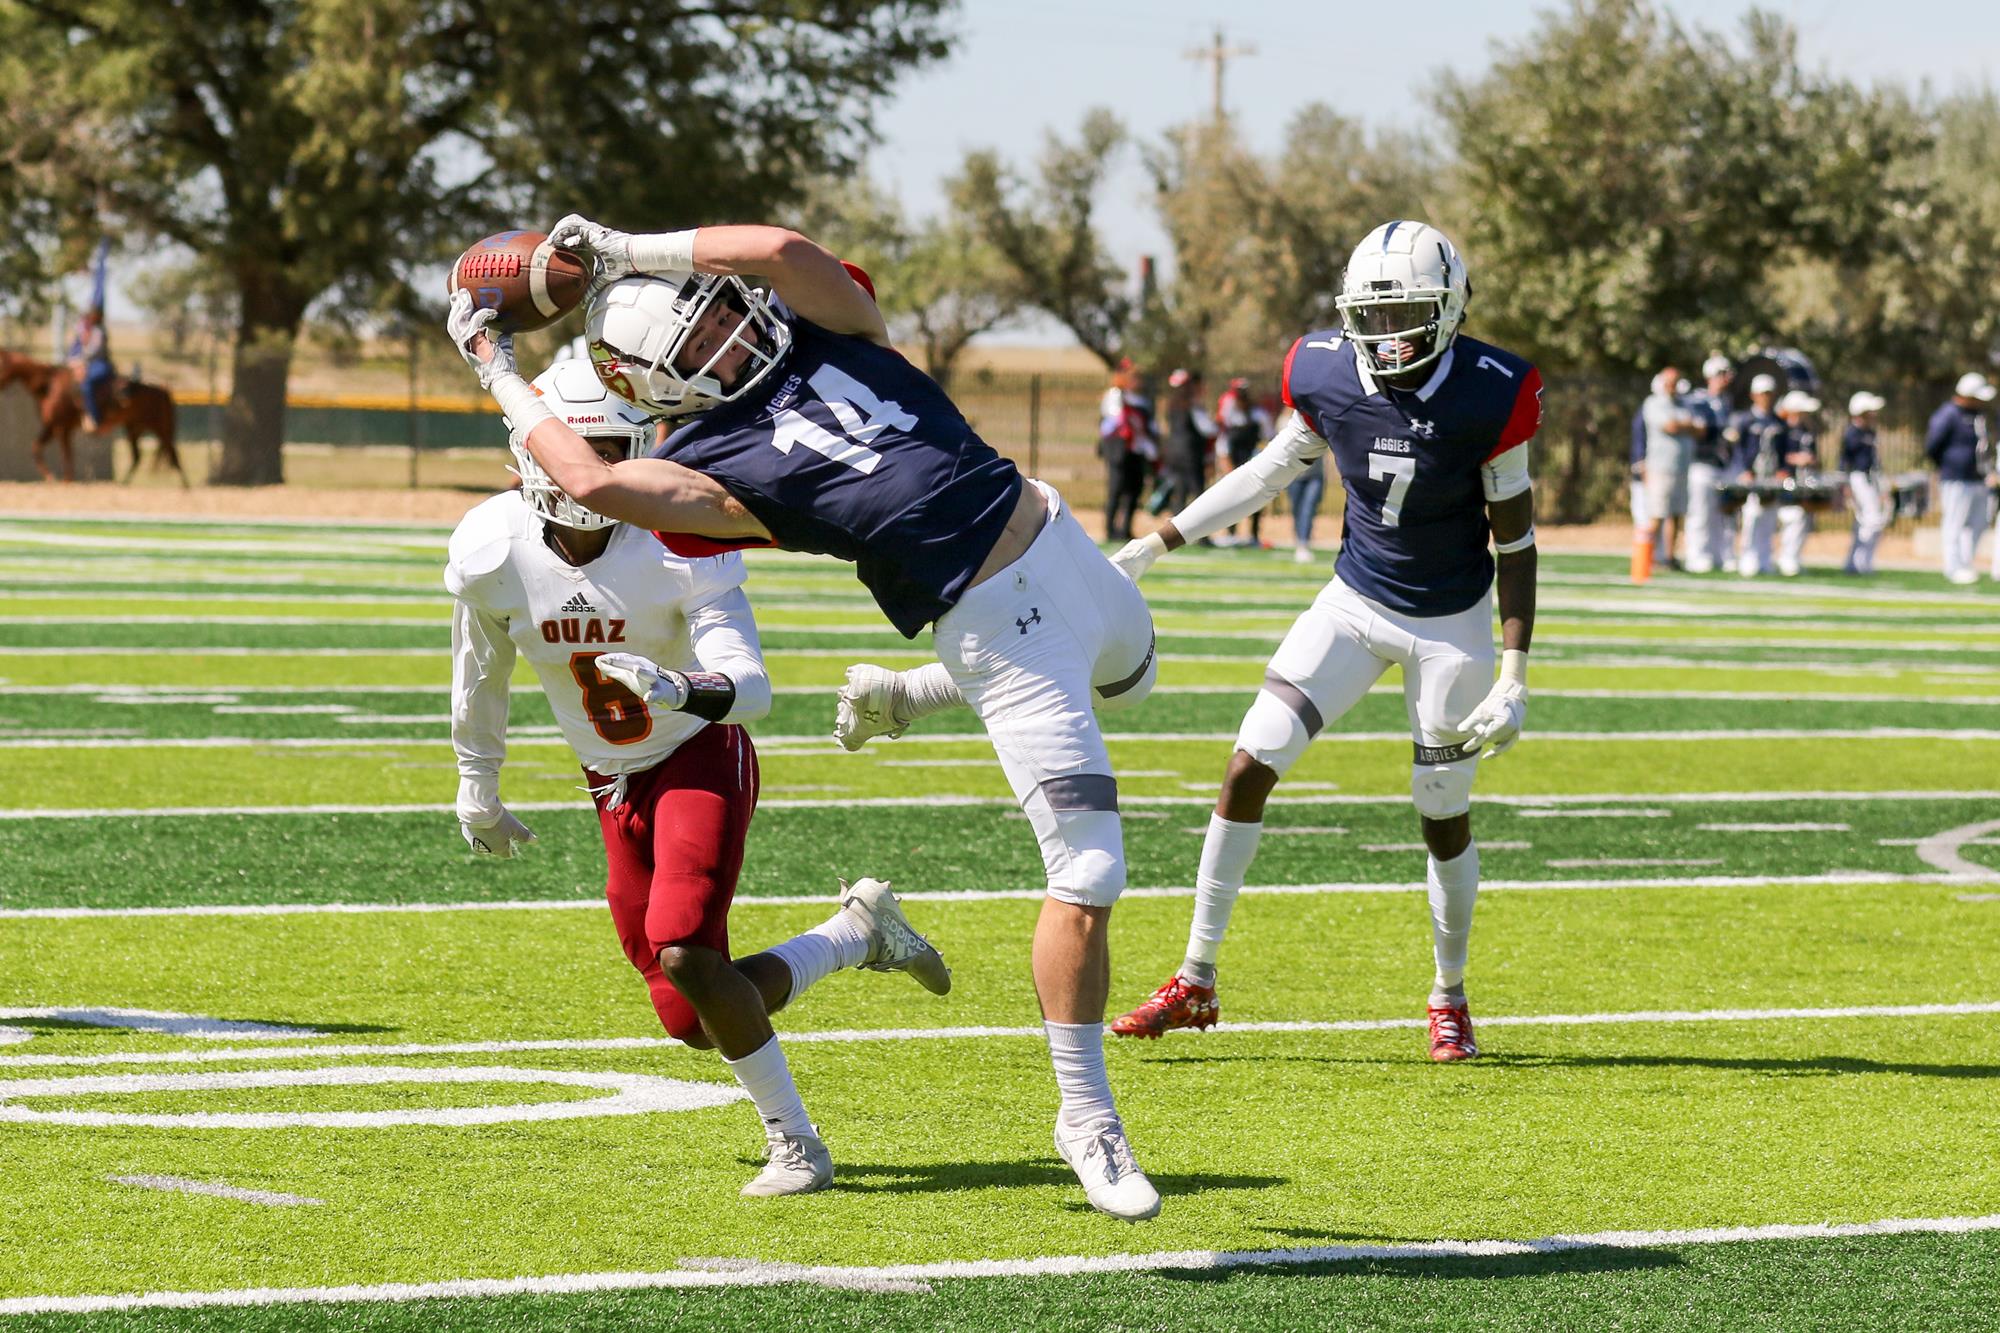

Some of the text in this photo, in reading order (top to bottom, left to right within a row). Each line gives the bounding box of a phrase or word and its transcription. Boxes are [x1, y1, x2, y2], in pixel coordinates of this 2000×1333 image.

[1306, 337, 1343, 351] 7
[1477, 355, 1514, 378] 7
[765, 374, 802, 415] AGGIES
[567, 415, 605, 424] Riddell
[771, 363, 919, 475] 14
[1373, 437, 1410, 453] AGGIES
[1368, 452, 1416, 527] 7
[561, 604, 597, 613] adidas
[540, 617, 626, 644] OUAZ
[1420, 747, 1458, 762] AGGIES
[882, 914, 928, 952] adidas
